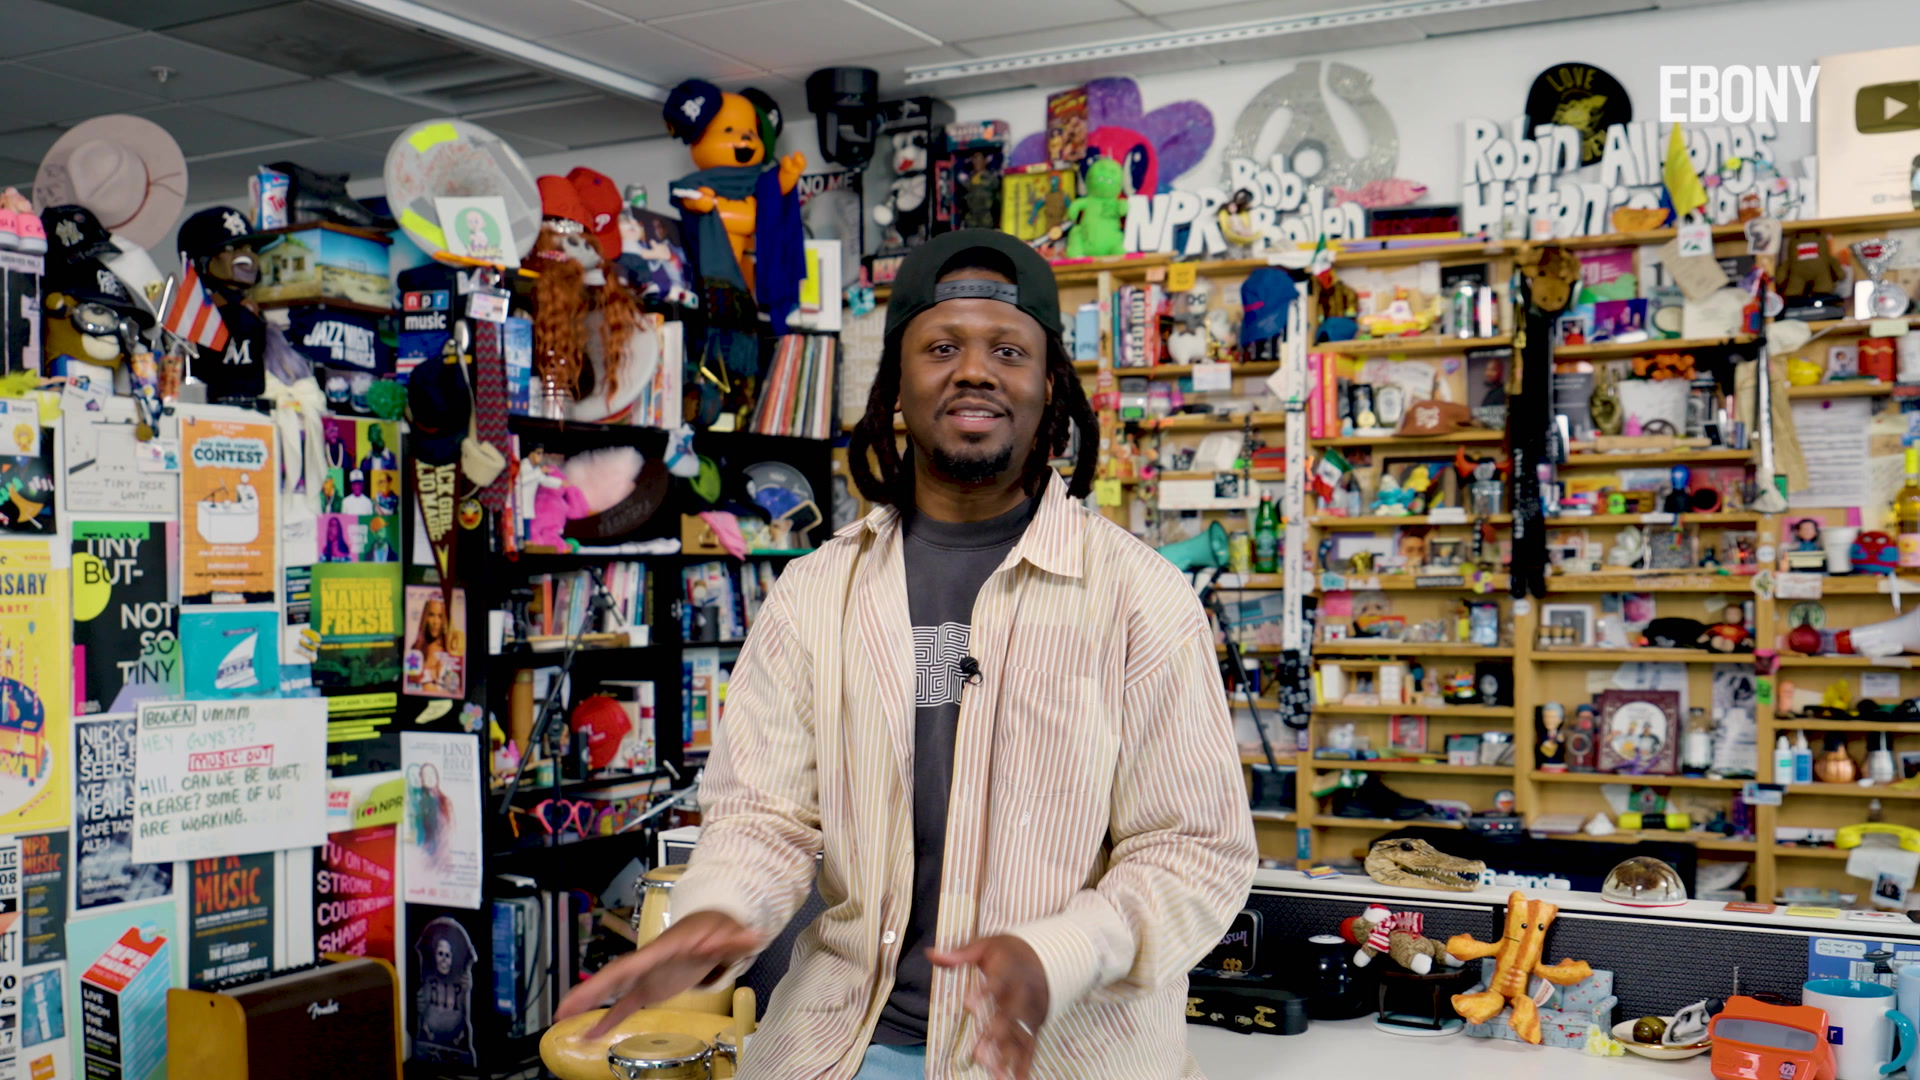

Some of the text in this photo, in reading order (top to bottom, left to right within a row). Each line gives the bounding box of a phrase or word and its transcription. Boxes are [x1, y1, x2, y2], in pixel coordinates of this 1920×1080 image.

[1546, 67, 1596, 92] LOVE
[1464, 114, 1581, 184] Robin
[1601, 121, 1661, 188] All
[1231, 153, 1302, 211] Bob
[1462, 178, 1608, 239] Hilton
[1123, 191, 1229, 256] NPR
[1252, 187, 1366, 258] Boilen
[407, 294, 445, 309] npr
[303, 320, 344, 347] JAZZ
[404, 311, 447, 331] music
[194, 448, 263, 463] CONTEST
[82, 533, 143, 558] TINY
[0, 573, 47, 595] SARY
[84, 559, 143, 585] BUT-
[321, 590, 392, 609] MANNIE
[121, 602, 174, 629] NOT
[320, 609, 394, 635] FRESH
[140, 630, 175, 655] SO
[116, 659, 175, 685] TINY
[146, 708, 193, 726] BOWEN
[79, 725, 120, 745] NICK
[80, 760, 136, 782] SEEDS
[181, 773, 212, 792] CAN
[216, 771, 235, 786] WE
[244, 767, 261, 785] BE
[80, 780, 125, 806] YEAH
[378, 796, 405, 815] NPR
[81, 797, 135, 823] YEAHS
[140, 820, 170, 839] ARE
[22, 835, 49, 855] NPR
[22, 853, 62, 876] MUSIC
[195, 867, 262, 915] MUSIC
[83, 988, 104, 1005] LIVE
[84, 1000, 111, 1019] FROM
[85, 1012, 103, 1028] THE
[1778, 1062, 1797, 1076] 429
